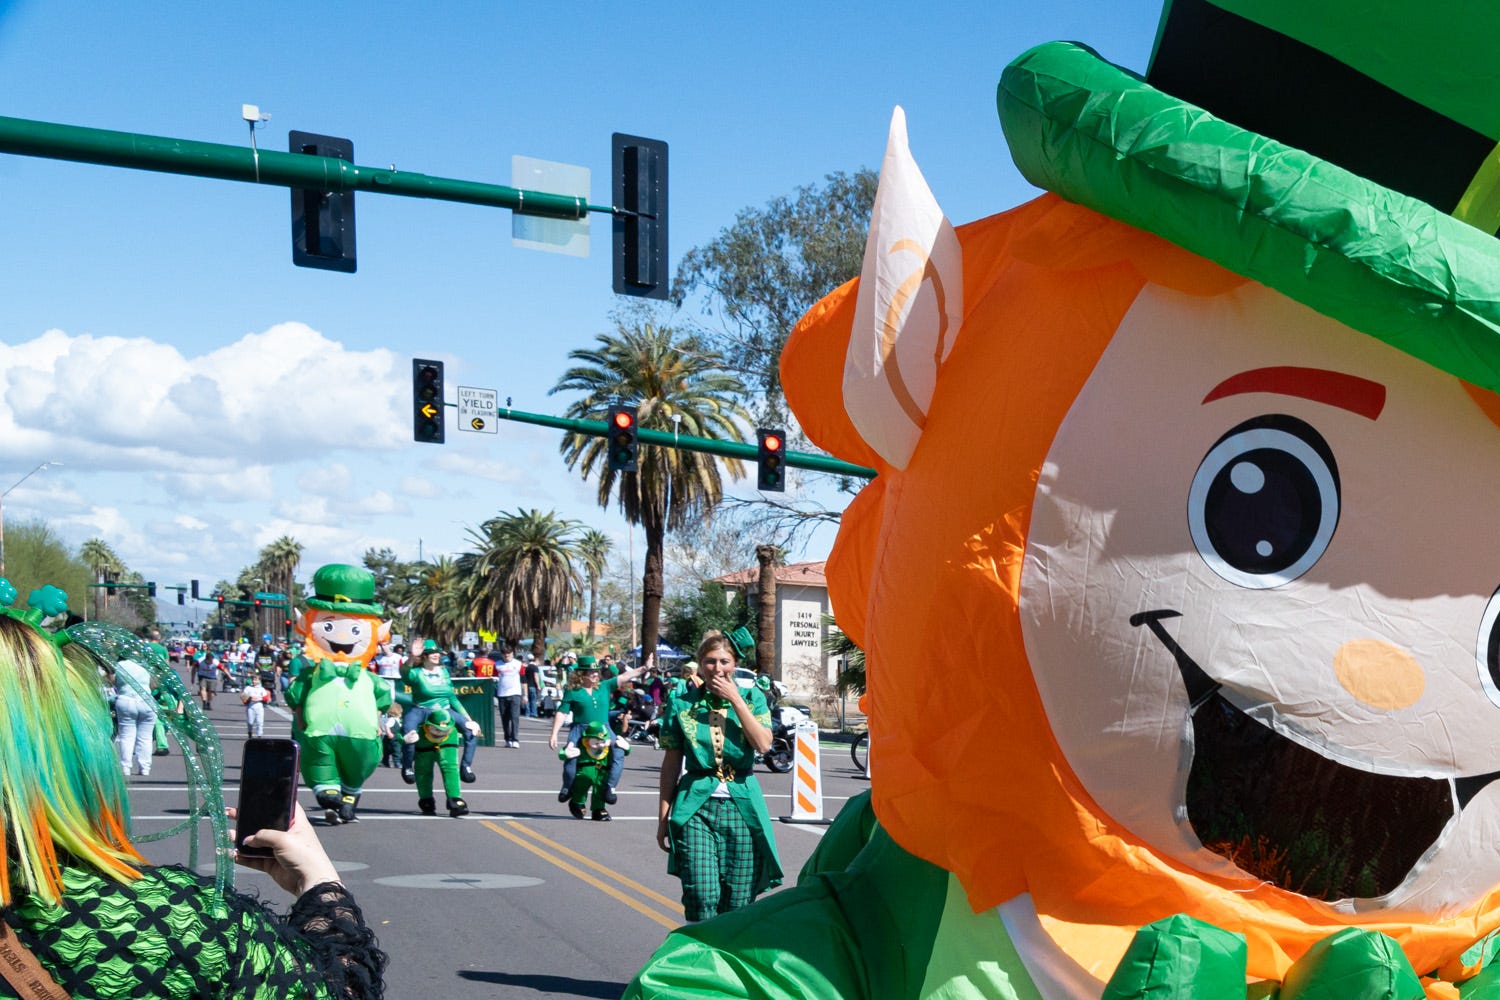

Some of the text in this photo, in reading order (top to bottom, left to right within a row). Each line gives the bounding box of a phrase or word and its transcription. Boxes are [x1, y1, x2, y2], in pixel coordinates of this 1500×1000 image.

[463, 398, 493, 409] YIELD
[790, 621, 819, 629] PERSONAL
[794, 630, 815, 638] INJURY
[791, 639, 818, 647] LAWYERS
